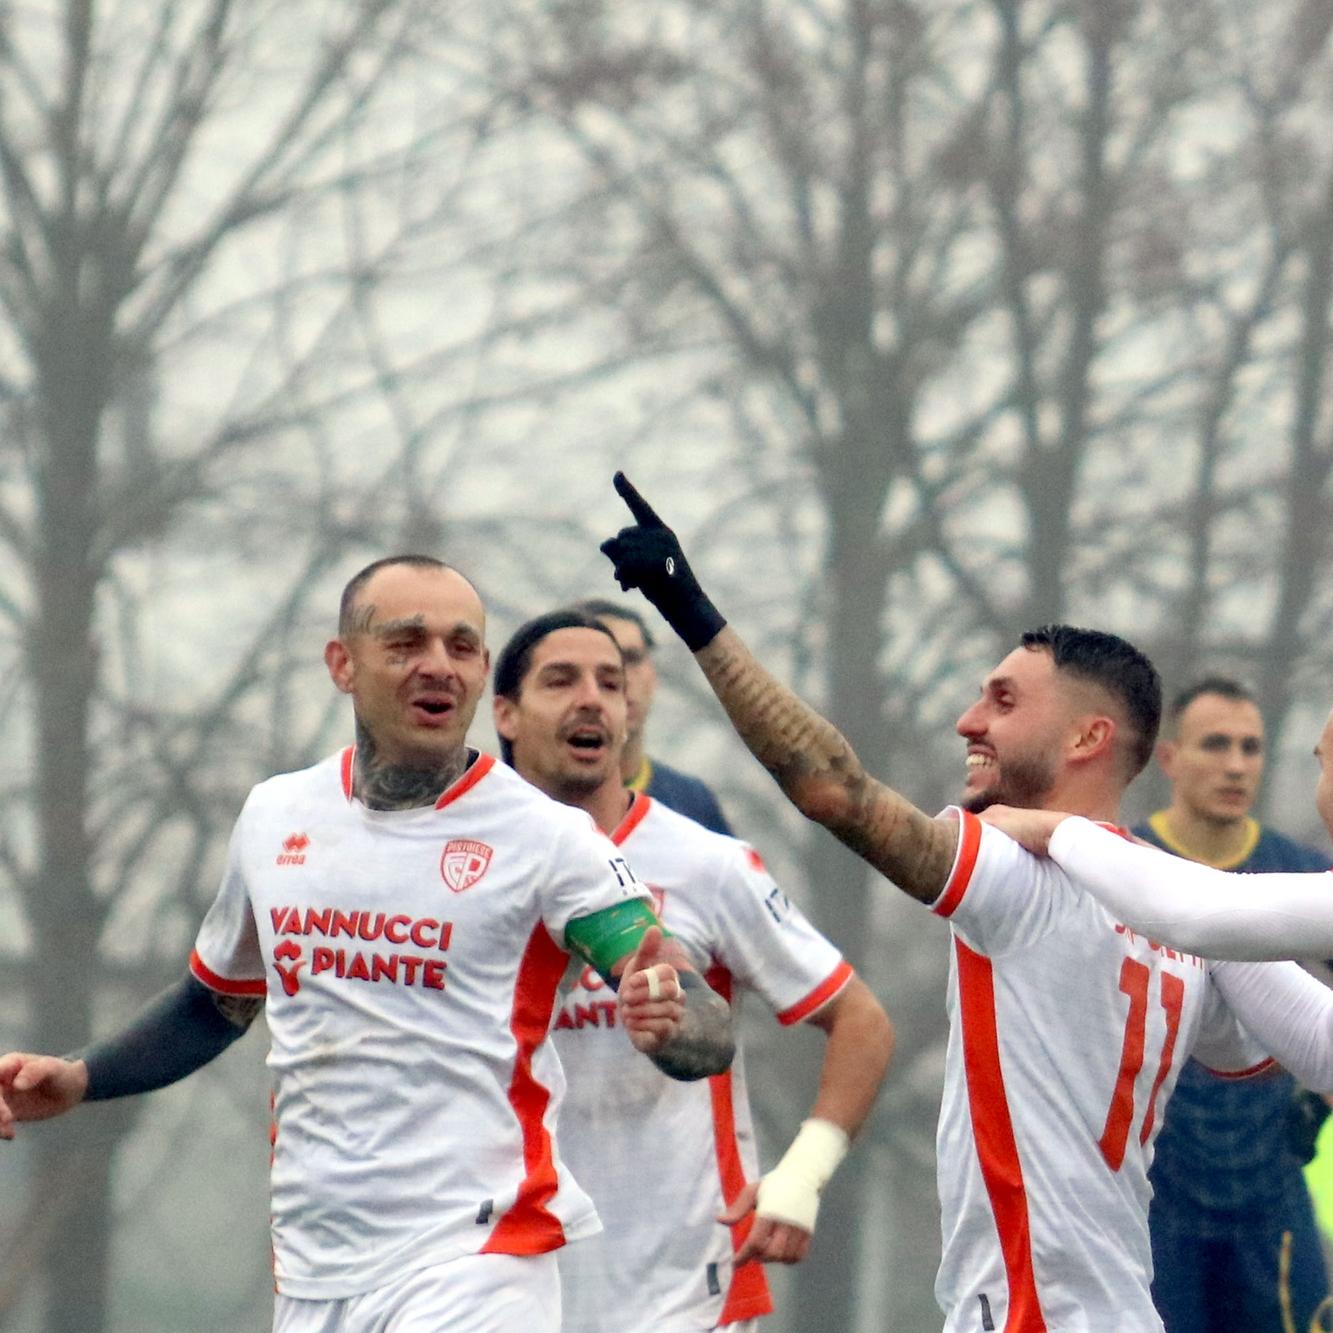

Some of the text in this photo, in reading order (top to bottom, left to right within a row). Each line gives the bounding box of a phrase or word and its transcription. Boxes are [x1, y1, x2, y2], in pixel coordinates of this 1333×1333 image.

[270, 906, 453, 951] VANNUCCI
[311, 946, 448, 991] PIANTE
[1096, 956, 1185, 1173] 11
